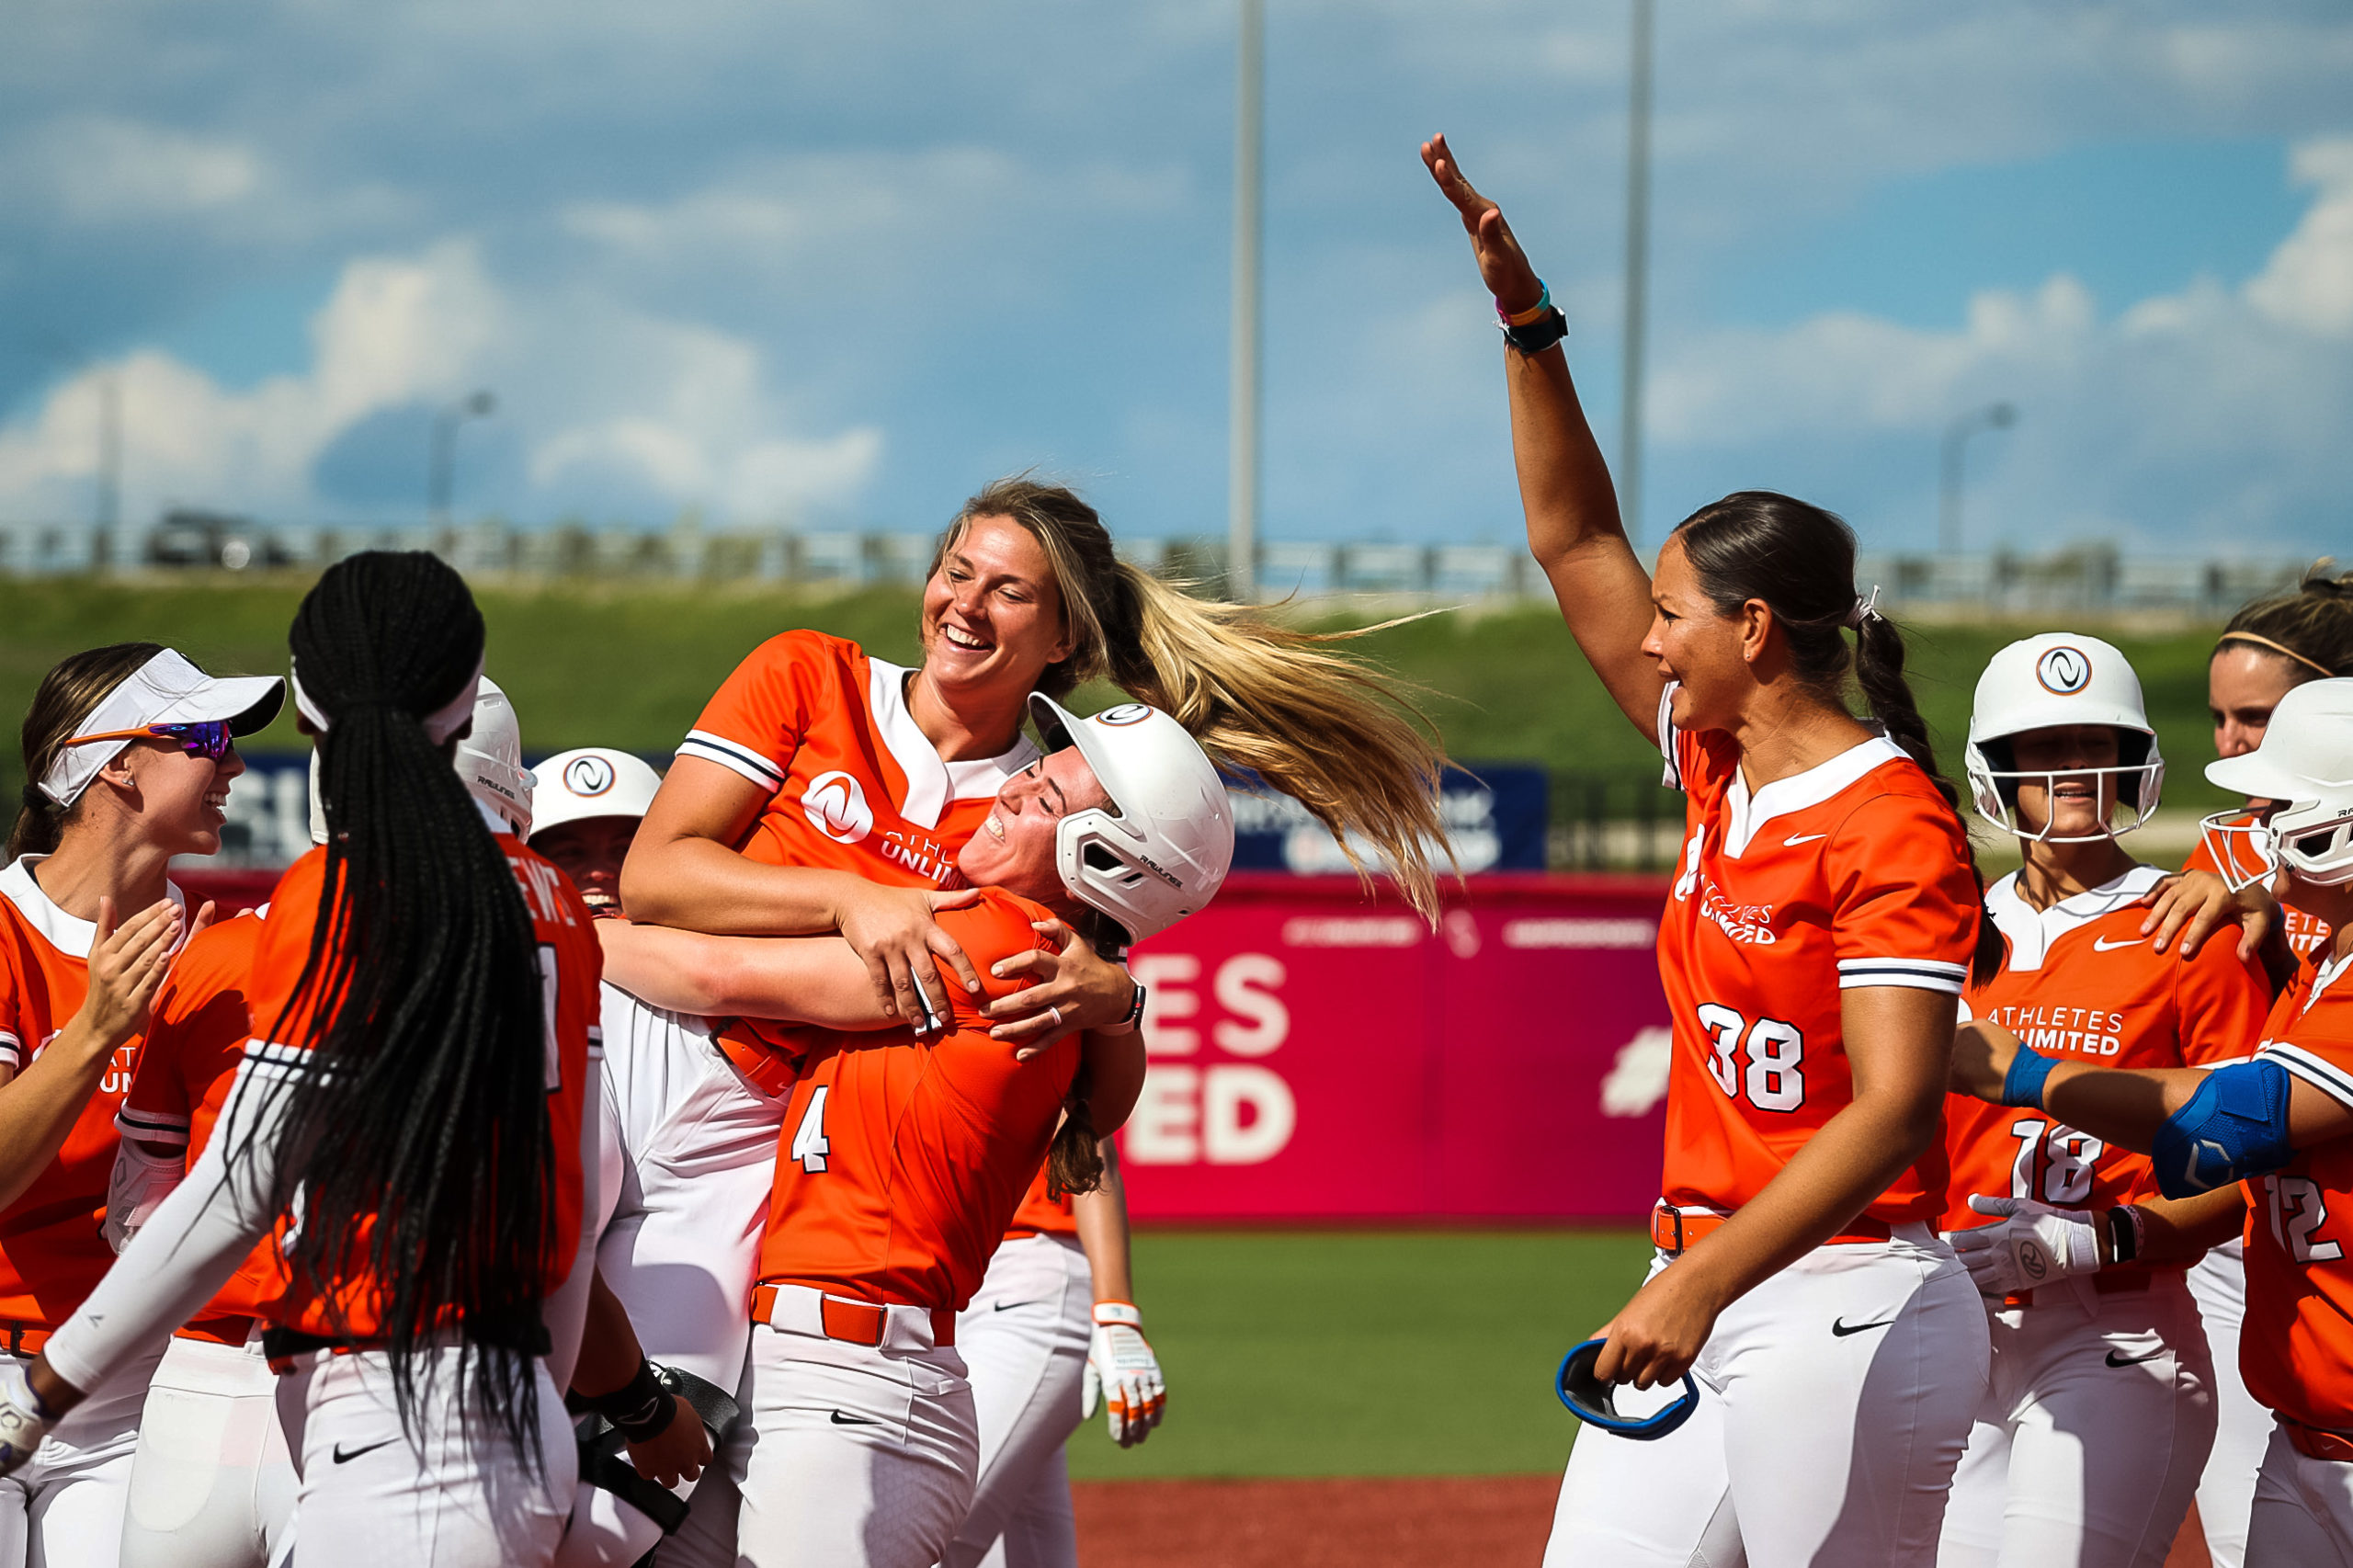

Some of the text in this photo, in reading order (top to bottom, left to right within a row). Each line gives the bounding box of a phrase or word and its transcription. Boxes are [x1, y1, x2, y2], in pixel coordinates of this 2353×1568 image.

[1696, 1001, 1806, 1114] 38
[1987, 1006, 2124, 1034] ATHLETES
[790, 1085, 831, 1175] 4
[2010, 1118, 2105, 1204] 18
[2263, 1172, 2346, 1266] 12
